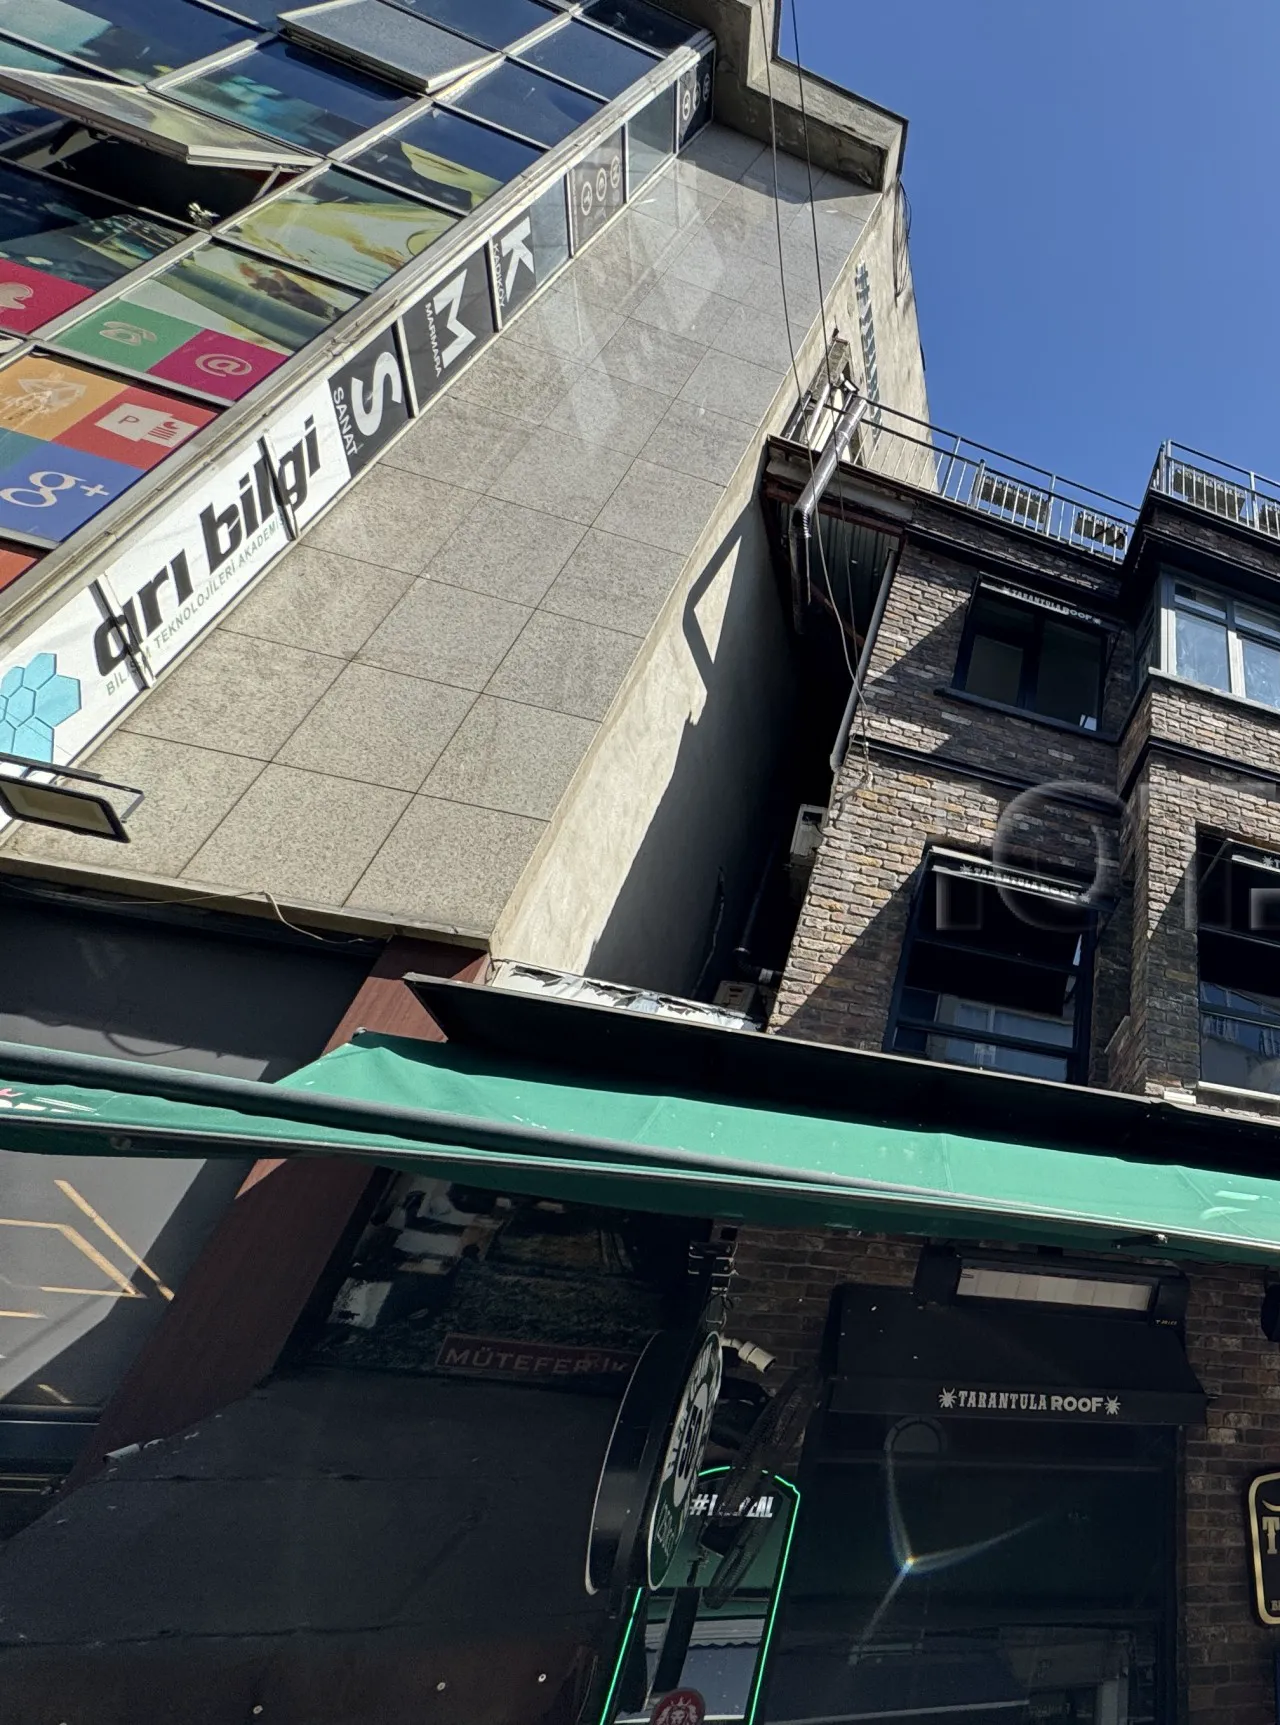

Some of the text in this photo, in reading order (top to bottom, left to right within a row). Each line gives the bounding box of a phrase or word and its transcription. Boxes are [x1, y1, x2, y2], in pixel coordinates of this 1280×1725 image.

[501, 216, 535, 301] K
[425, 302, 443, 379] MARMARA
[333, 387, 358, 456] SANAT
[351, 351, 402, 437] S
[199, 414, 322, 576] bilgi
[153, 560, 238, 650] TEKNOLOJİLERİ
[1062, 606, 1093, 621] ROOF
[958, 1390, 1105, 1413] TARANTULA ROOF
